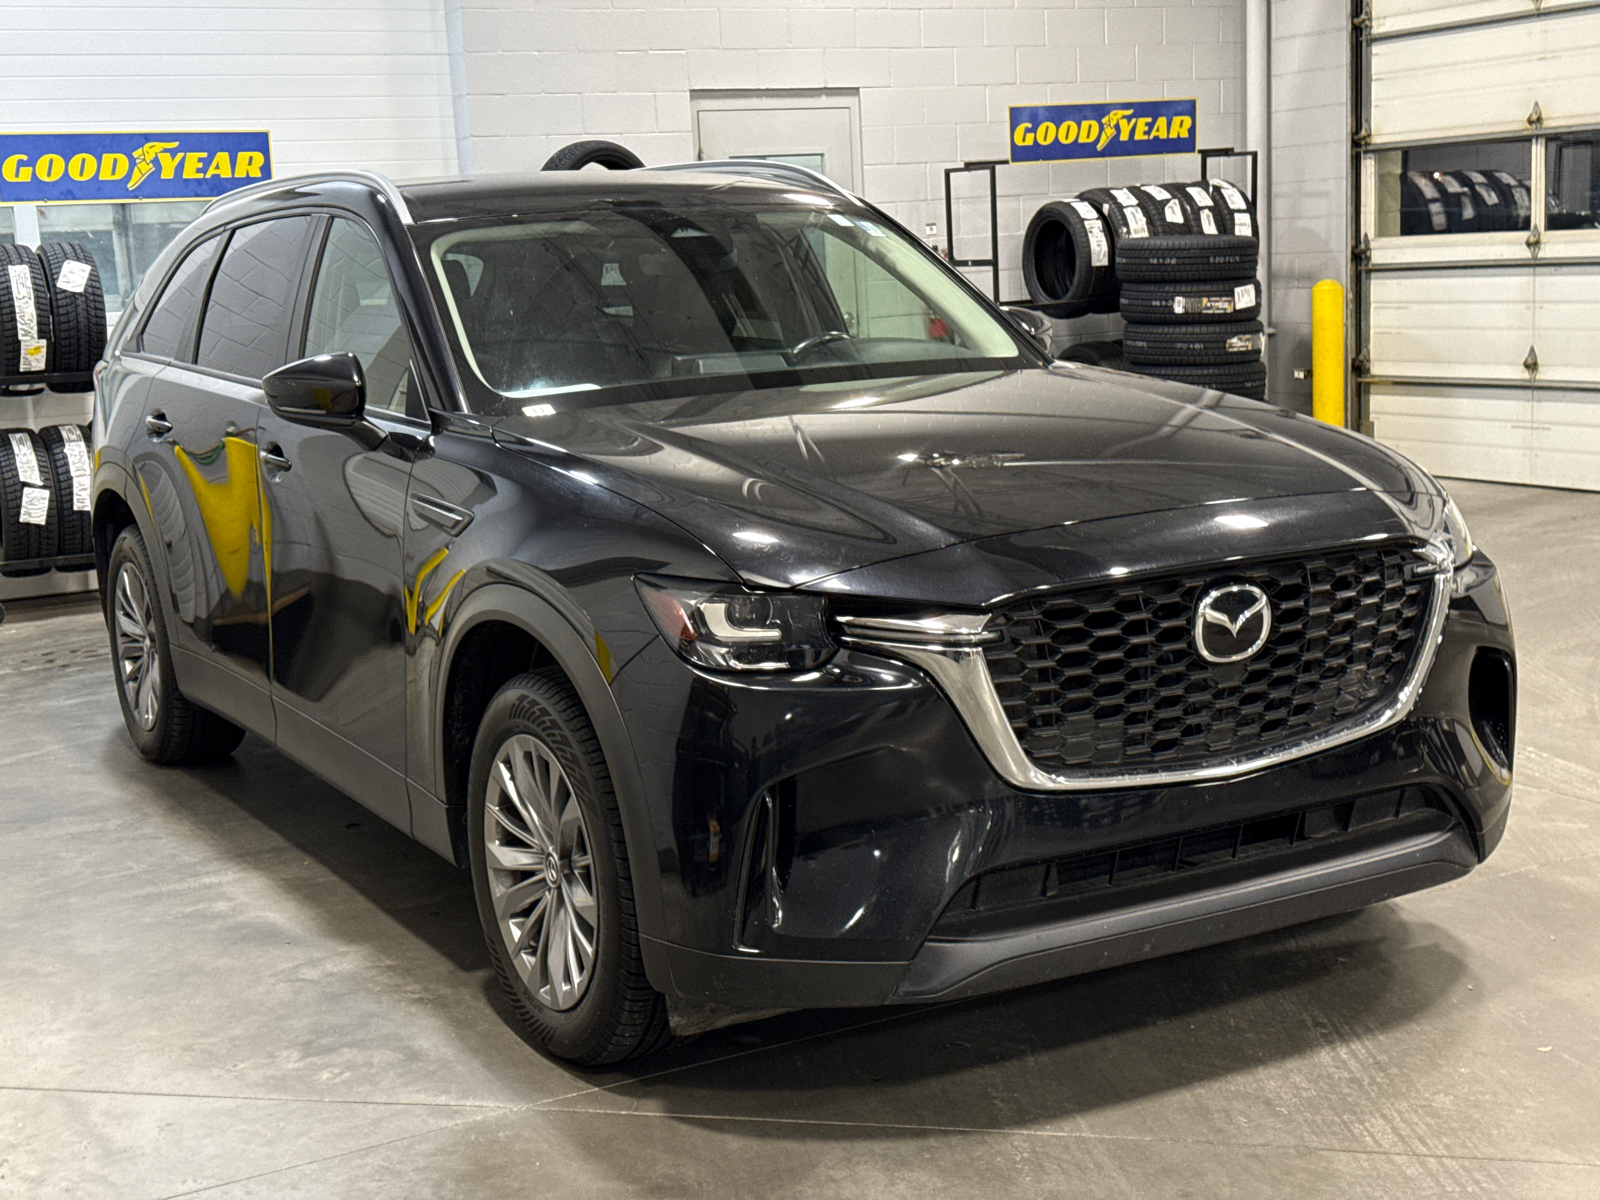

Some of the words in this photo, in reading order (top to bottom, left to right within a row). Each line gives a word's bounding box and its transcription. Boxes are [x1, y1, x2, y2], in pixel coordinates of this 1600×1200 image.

[1013, 120, 1100, 146] GOOD
[1118, 115, 1193, 141] YEAR
[2, 153, 129, 182] GOOD
[157, 151, 265, 179] YEAR
